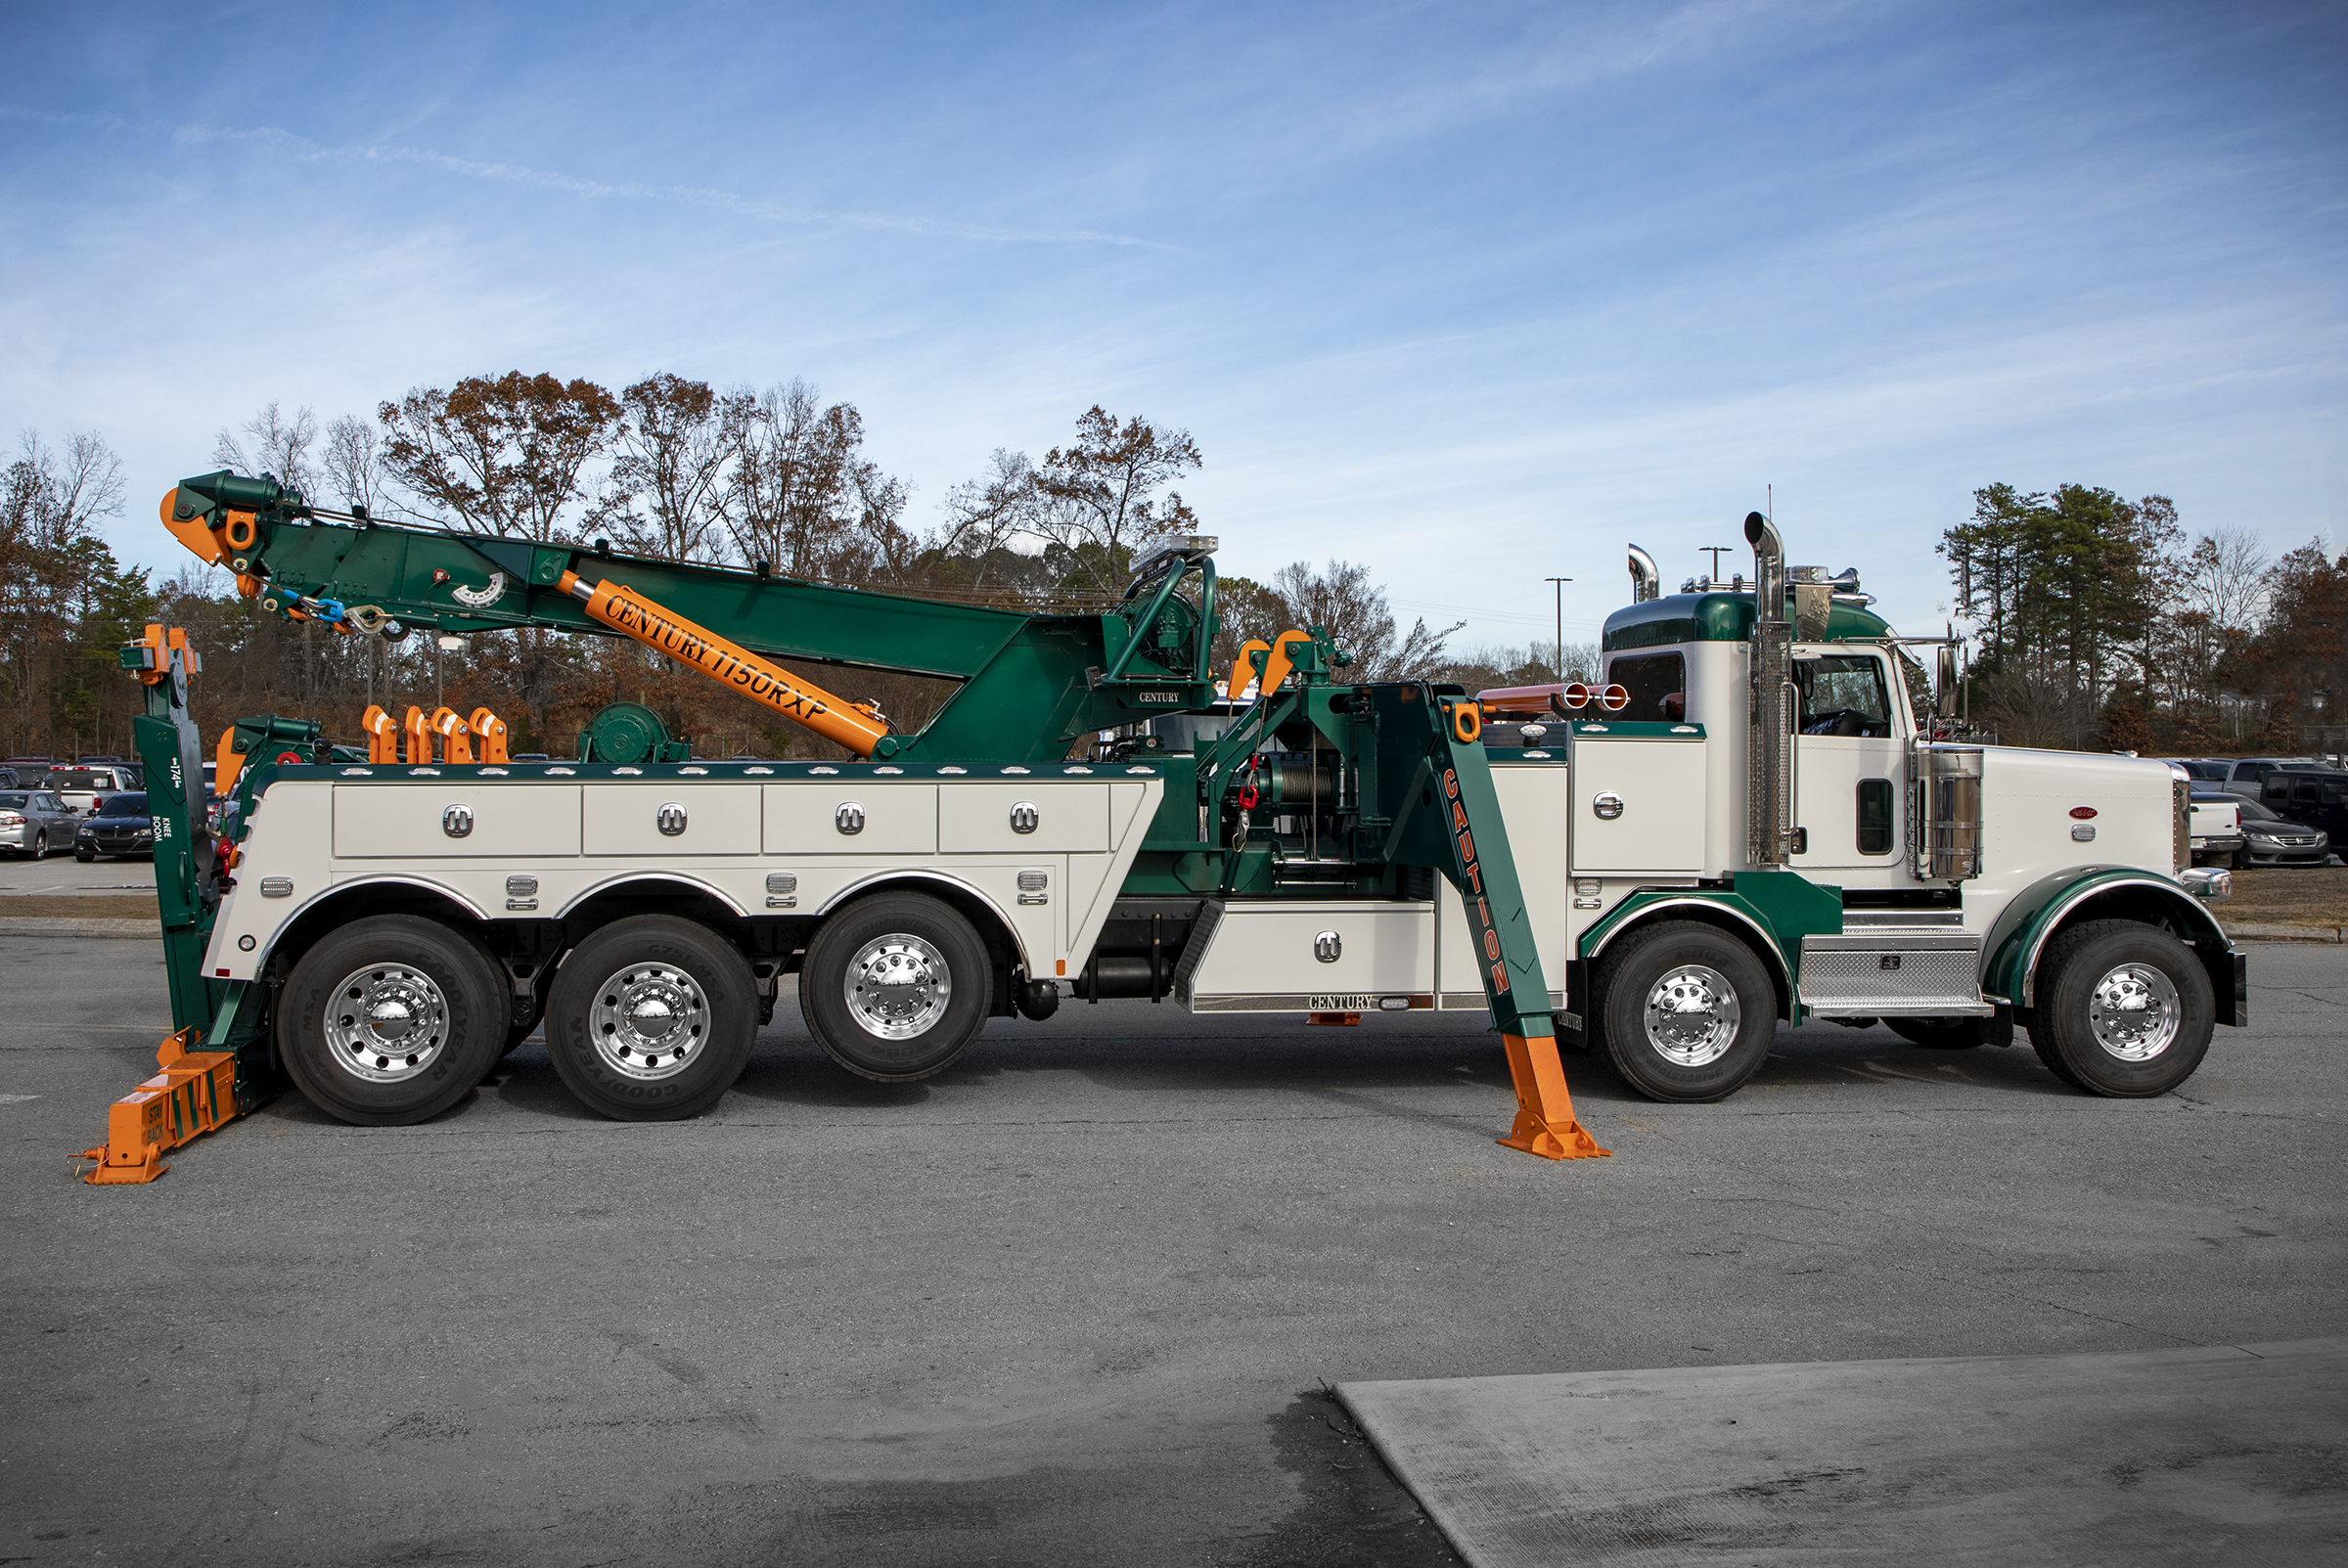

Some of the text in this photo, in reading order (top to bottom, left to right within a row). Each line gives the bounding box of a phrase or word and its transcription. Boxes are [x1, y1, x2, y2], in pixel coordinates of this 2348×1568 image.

[605, 595, 829, 721] CENTURY 1150RXP
[1139, 692, 1180, 702] CENTURY
[153, 816, 163, 842] BOOM
[161, 817, 172, 838] KNEE
[1442, 768, 1511, 996] CAUTION
[697, 963, 726, 1002] MSA
[302, 988, 322, 1032] MSA
[415, 953, 469, 1081] GOODYEAR
[1308, 994, 1374, 1010] CENTURY
[569, 1015, 679, 1099] GOODYEAR
[148, 1101, 163, 1125] STAY
[148, 1122, 164, 1146] BACK
